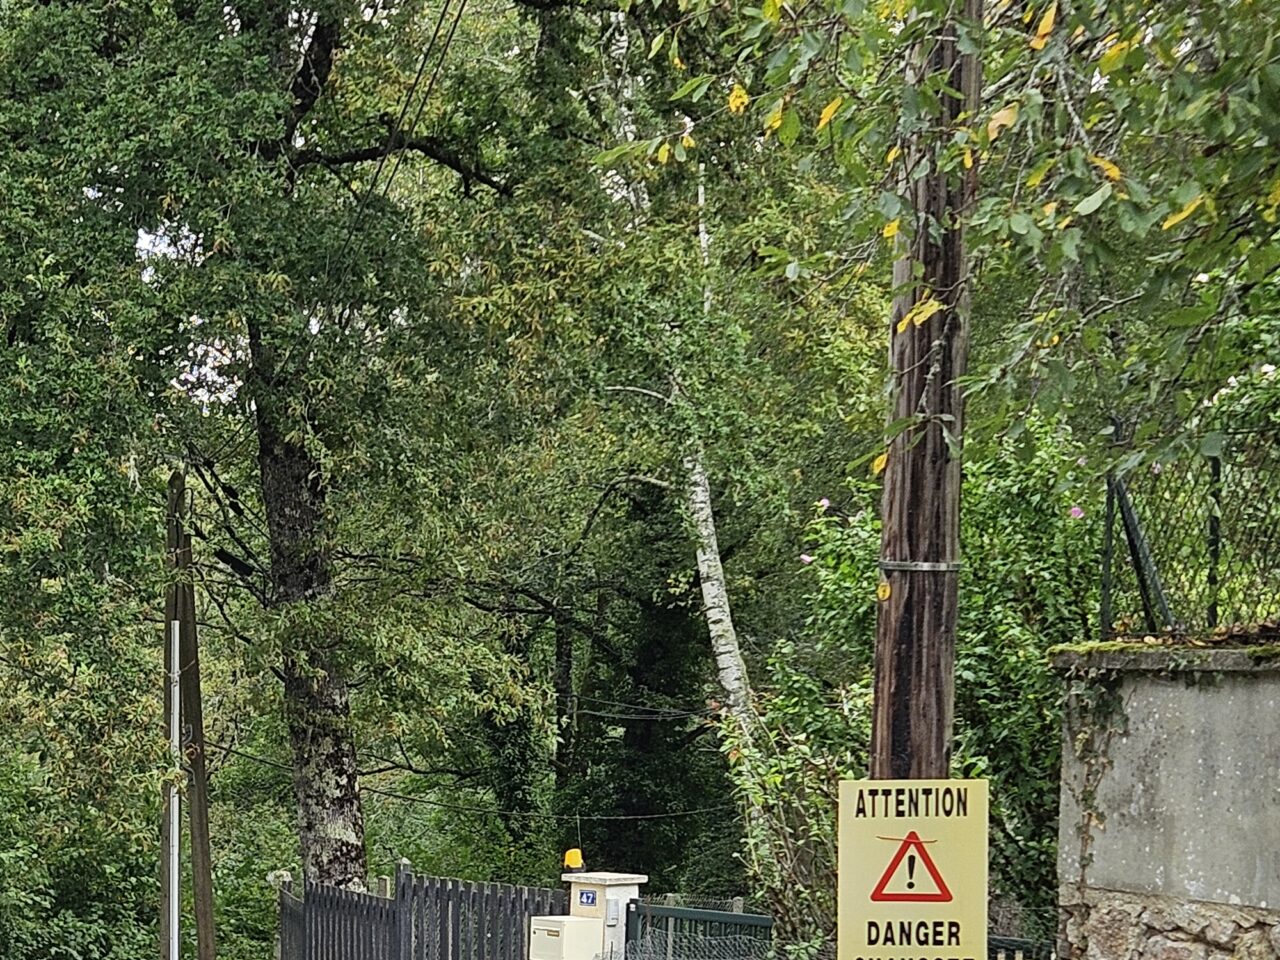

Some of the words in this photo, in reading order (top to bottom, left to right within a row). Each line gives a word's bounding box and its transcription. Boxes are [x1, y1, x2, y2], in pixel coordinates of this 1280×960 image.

[855, 787, 967, 817] ATTENTION
[581, 892, 593, 903] 47
[867, 921, 960, 946] DANGER
